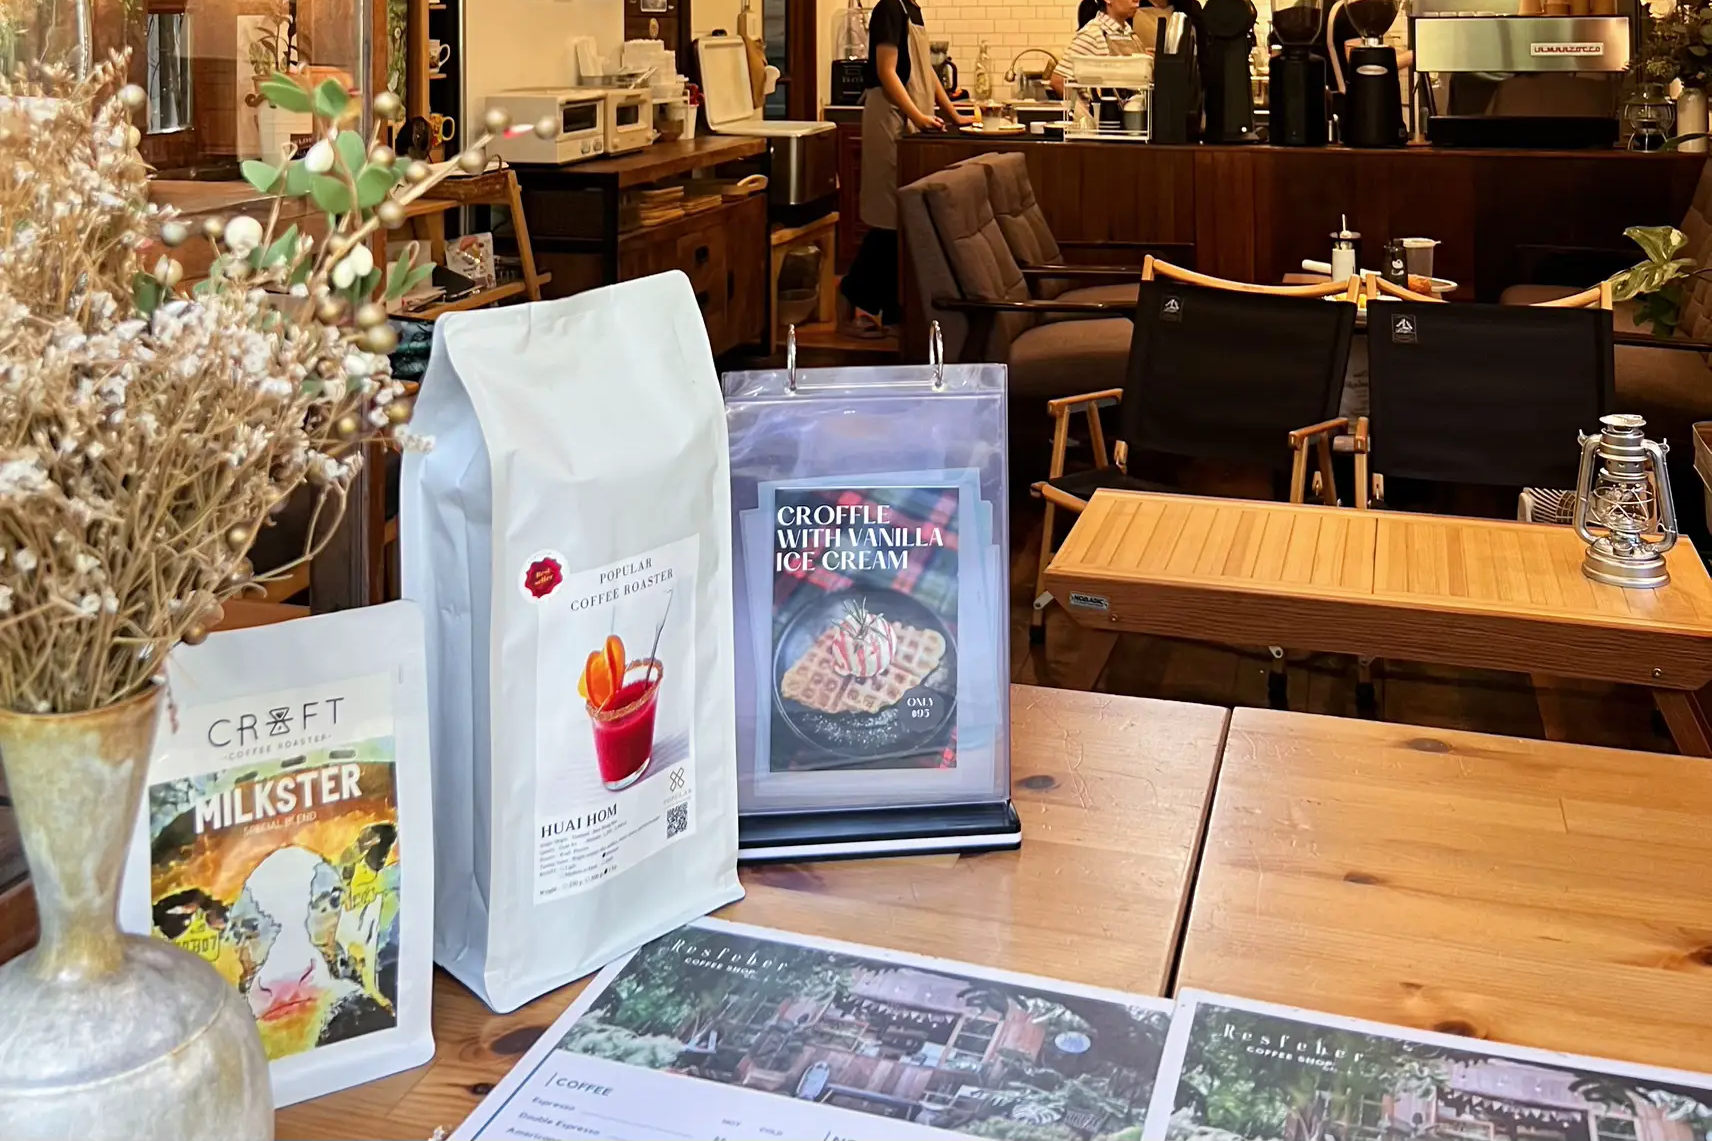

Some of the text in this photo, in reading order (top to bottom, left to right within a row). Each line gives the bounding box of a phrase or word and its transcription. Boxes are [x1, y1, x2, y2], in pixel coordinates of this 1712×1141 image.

[776, 505, 890, 526] CROFFLE
[777, 527, 944, 549] WITH VANILLA
[600, 558, 653, 584] POPULAR
[776, 550, 908, 572] ICE CREAM
[570, 568, 673, 611] COFFEE ROASTER
[906, 696, 934, 707] ONLY
[193, 761, 363, 835] MILKSTER
[541, 802, 618, 839] HUAI HOM
[684, 957, 757, 975] COFFEE SHOP
[1246, 1046, 1334, 1067] COFFEE SHOP
[555, 1077, 613, 1097] COFFEE
[532, 1096, 576, 1112] Espresso
[518, 1111, 601, 1137] Double Espresso
